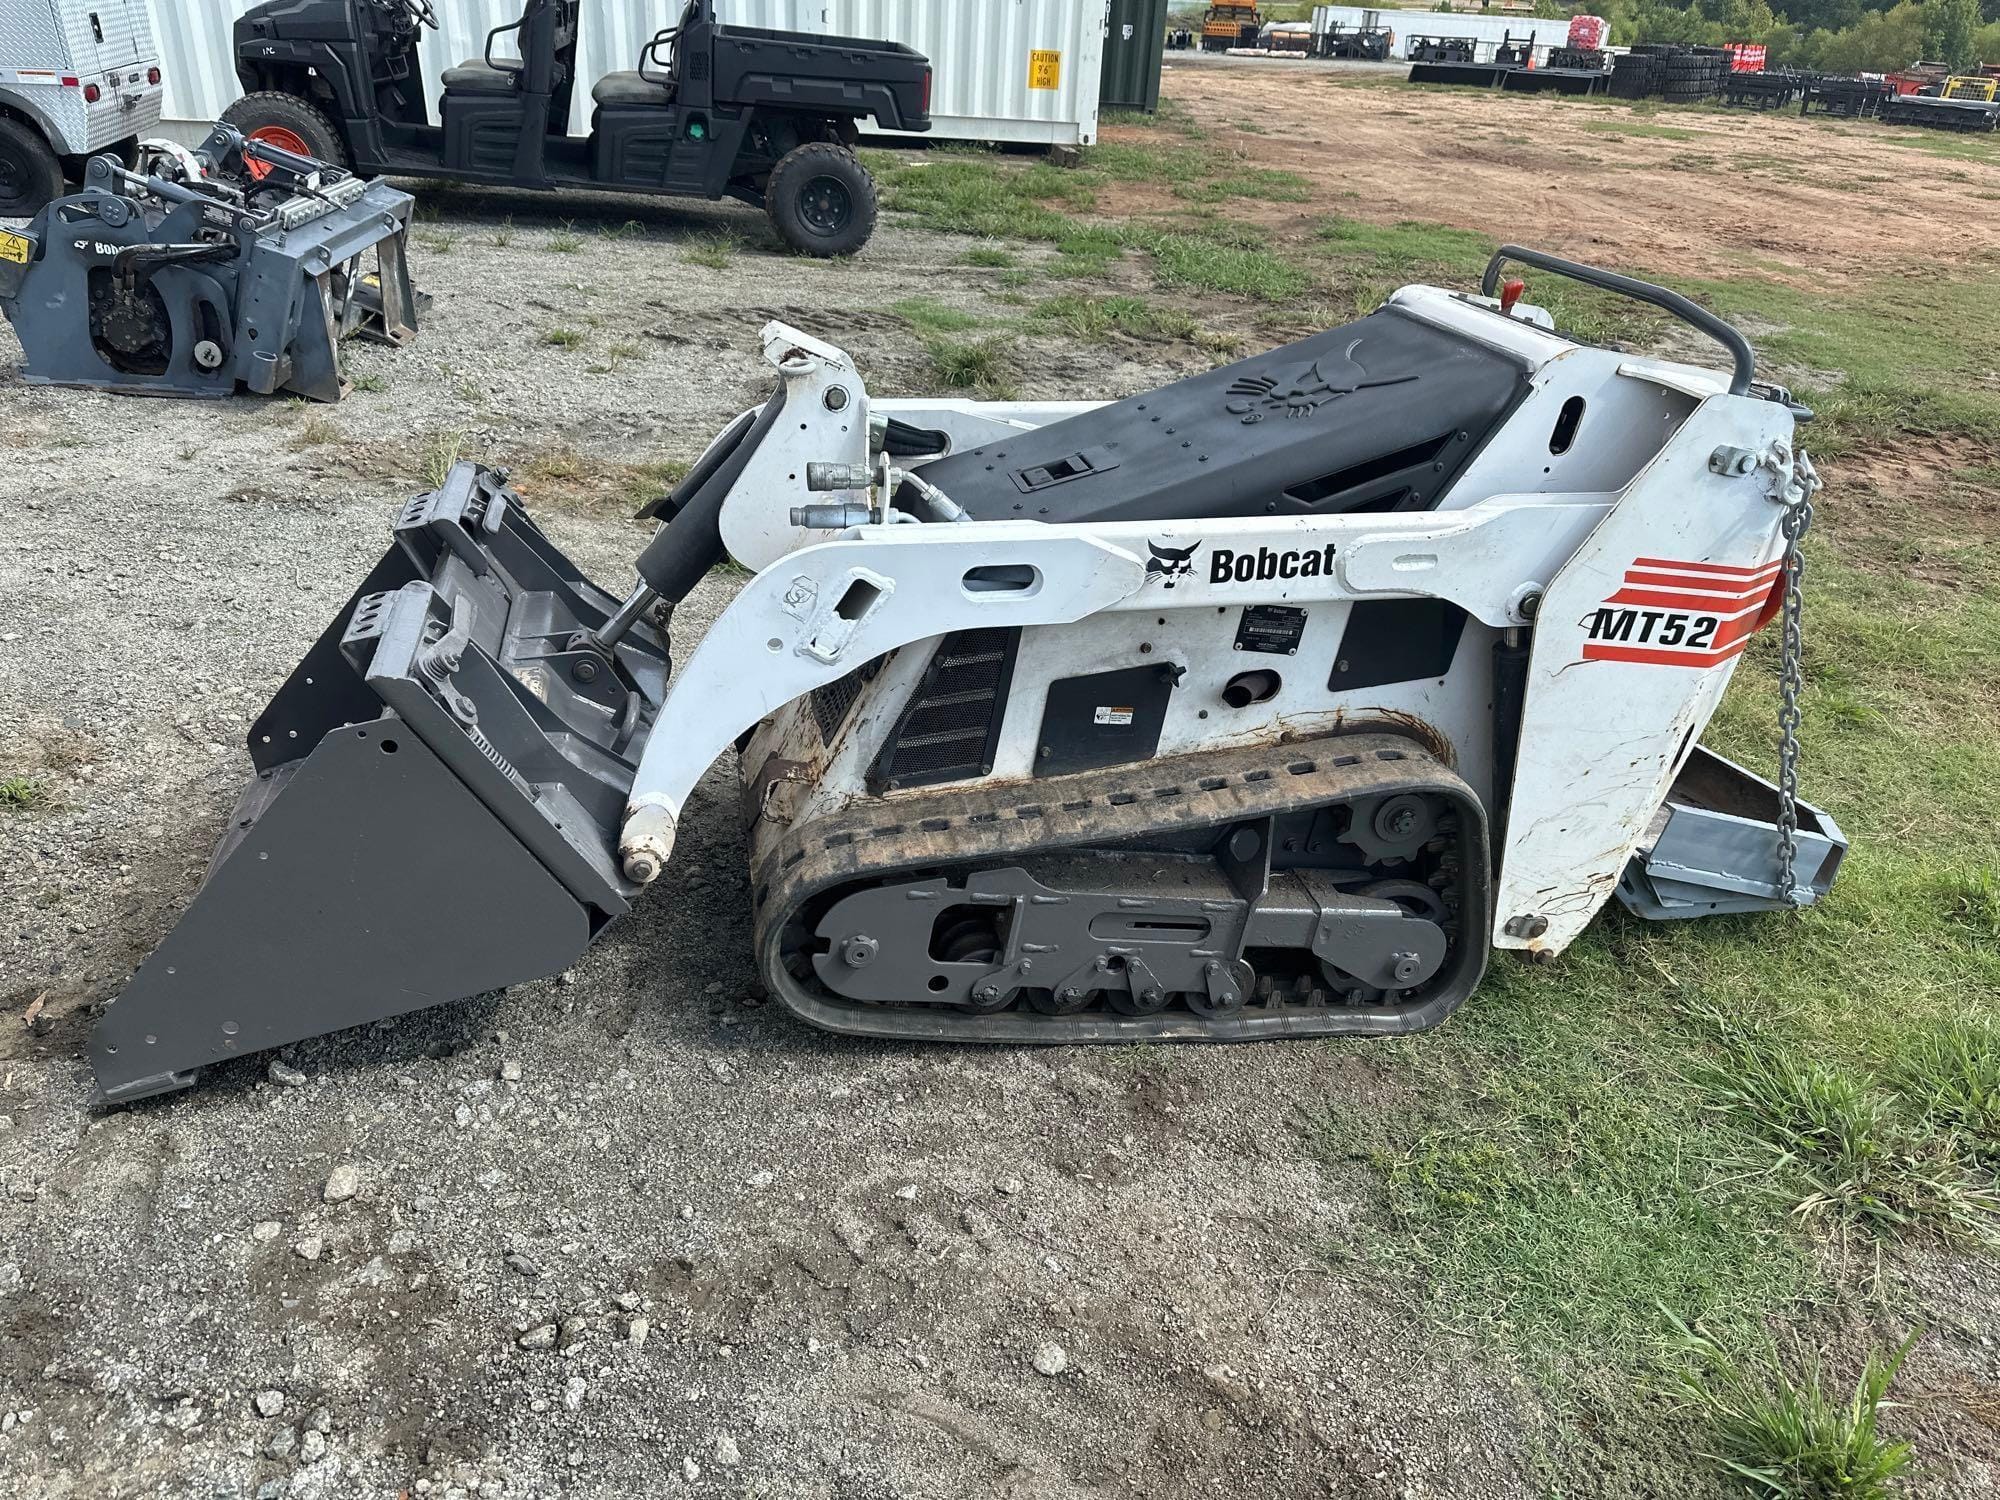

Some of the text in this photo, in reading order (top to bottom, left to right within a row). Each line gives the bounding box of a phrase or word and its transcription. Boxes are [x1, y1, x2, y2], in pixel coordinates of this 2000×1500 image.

[1032, 52, 1059, 64] CAUTION
[1036, 77, 1051, 87] HIGH
[1210, 543, 1337, 584] Bobcat
[1588, 607, 1718, 648] MT52
